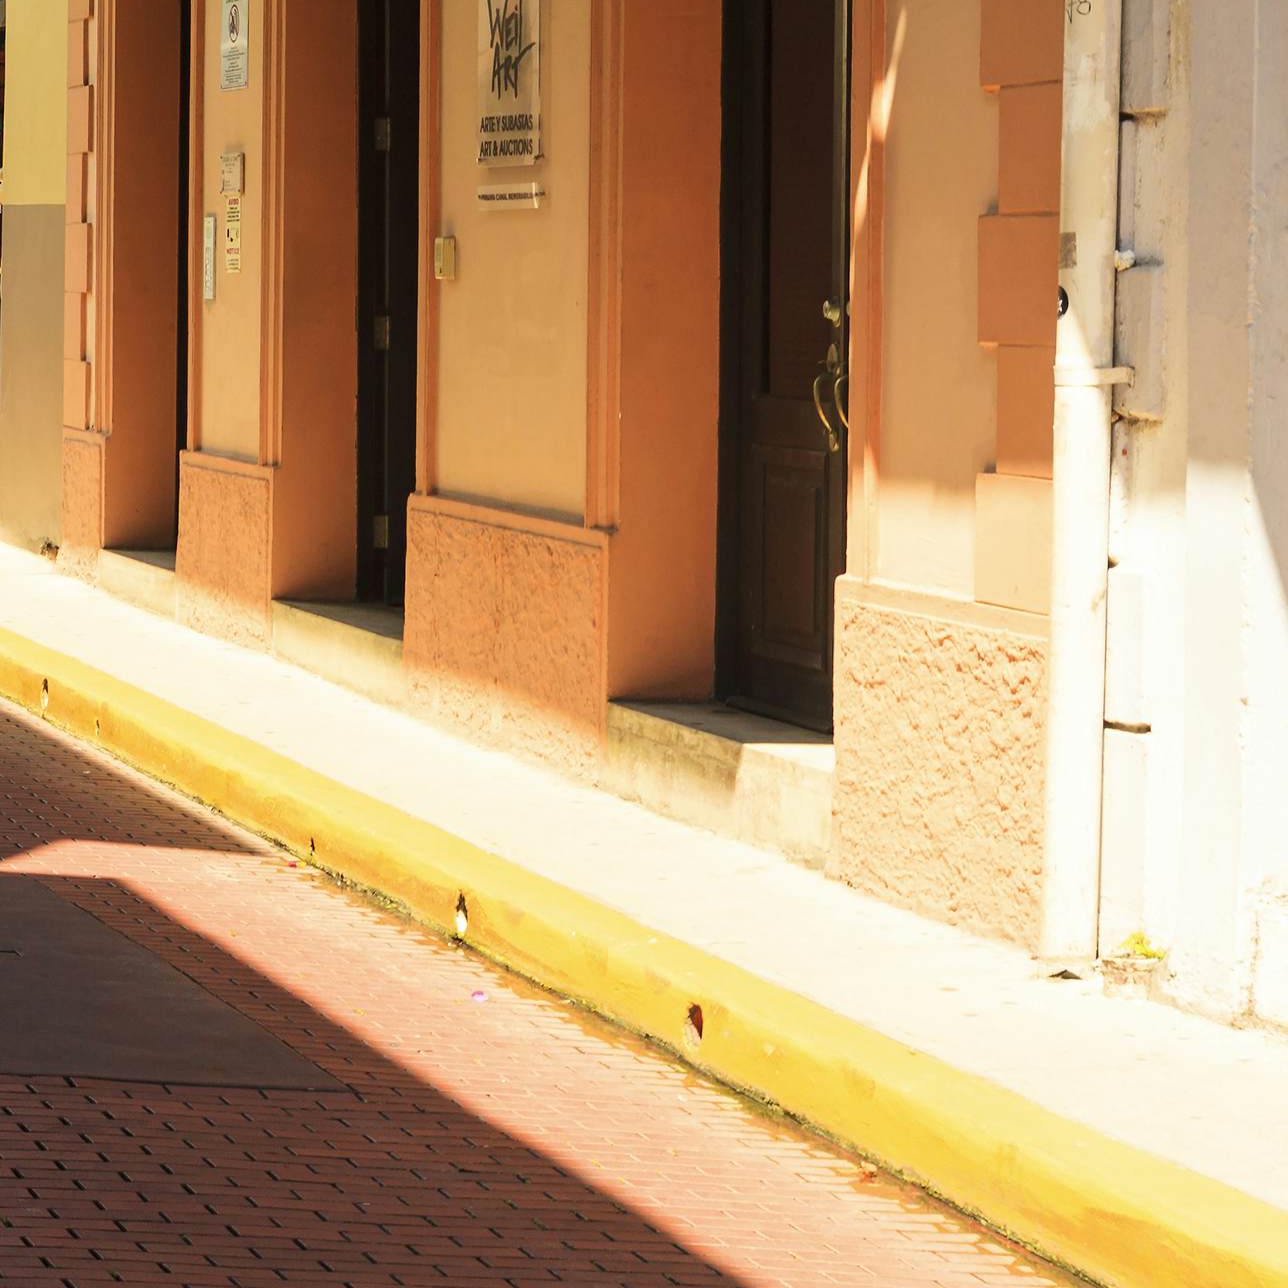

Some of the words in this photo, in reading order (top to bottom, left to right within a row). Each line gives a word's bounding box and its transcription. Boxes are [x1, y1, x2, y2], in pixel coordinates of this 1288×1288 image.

[480, 116, 496, 133] ARTE
[496, 116, 501, 132] Y
[502, 113, 533, 132] SUBASTAS
[480, 140, 492, 157] ART
[493, 140, 498, 157] &
[499, 138, 533, 156] AUCTIONS
